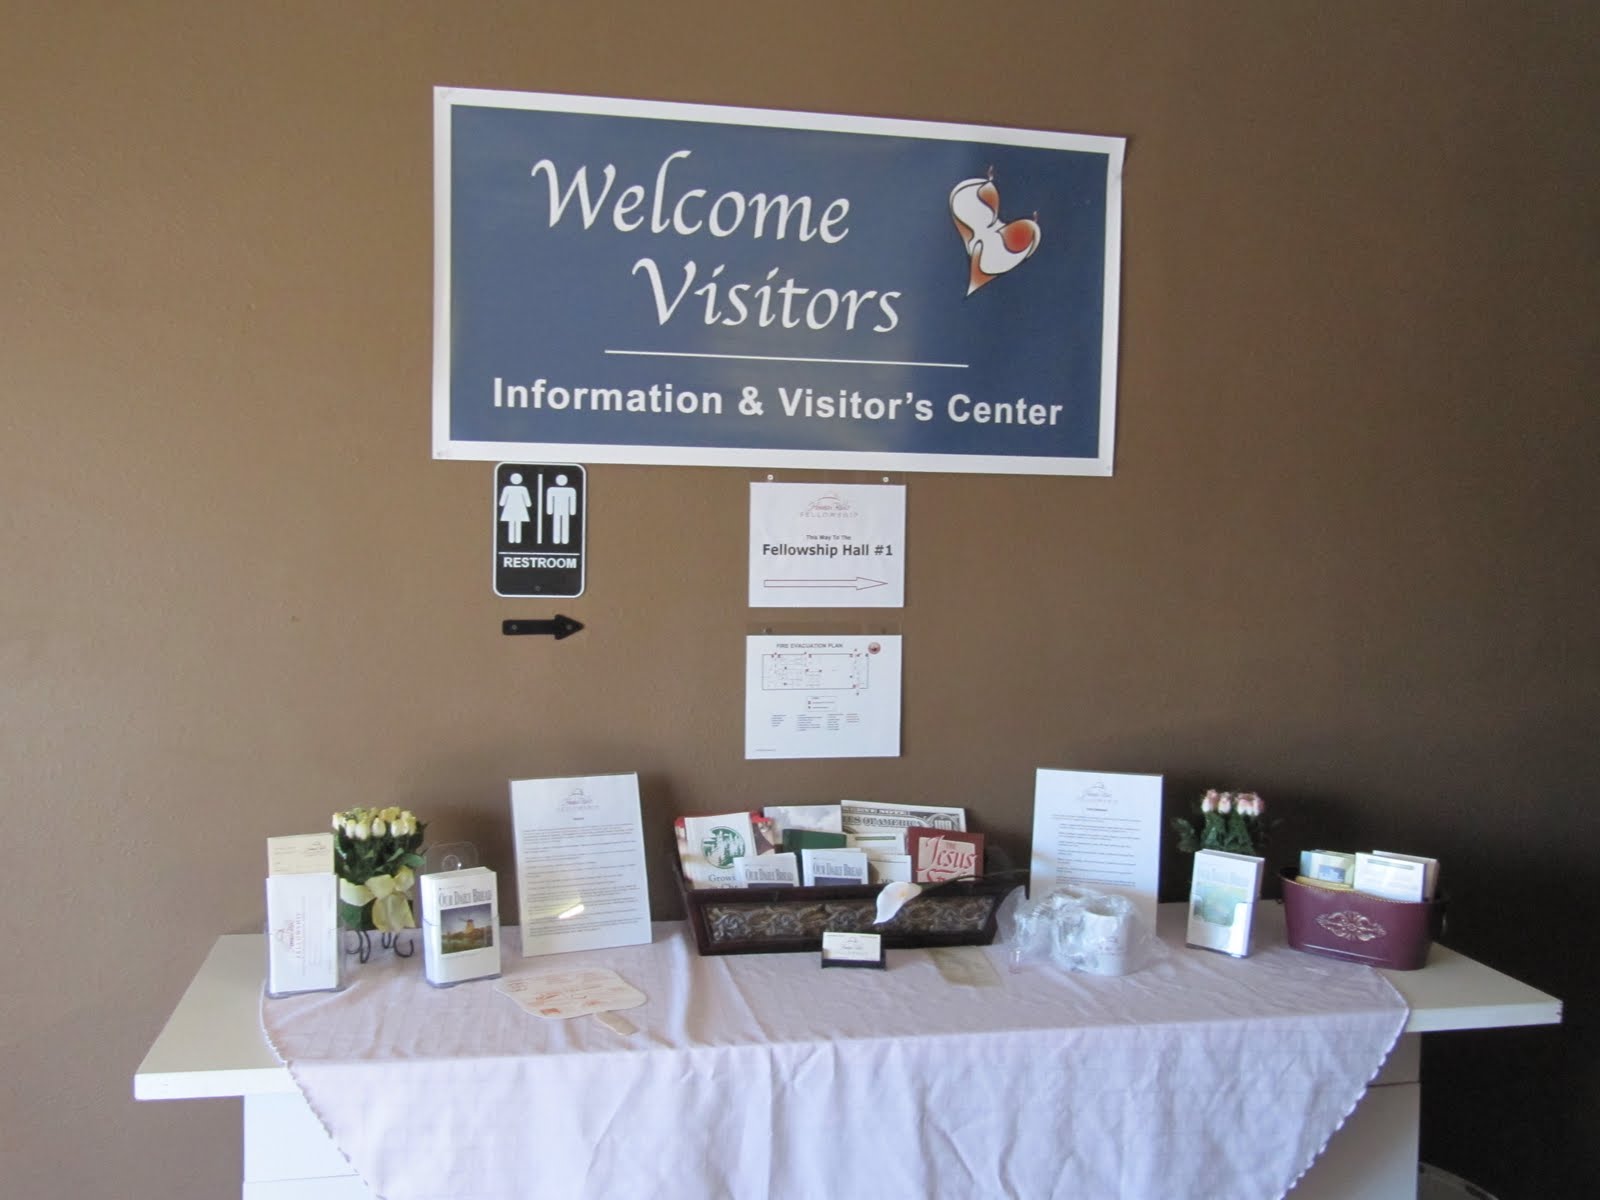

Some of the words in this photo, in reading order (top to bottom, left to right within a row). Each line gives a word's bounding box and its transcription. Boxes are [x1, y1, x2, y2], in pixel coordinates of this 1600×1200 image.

[530, 150, 850, 244] Welcome
[631, 257, 902, 334] Visitors
[493, 377, 723, 415] Information
[738, 385, 764, 416] &
[948, 393, 1063, 426] Center
[503, 556, 577, 569] RESTROOM
[762, 543, 838, 559] Fellowship
[842, 543, 870, 556] Hall
[874, 544, 893, 556] #1
[926, 835, 978, 869] Jesus
